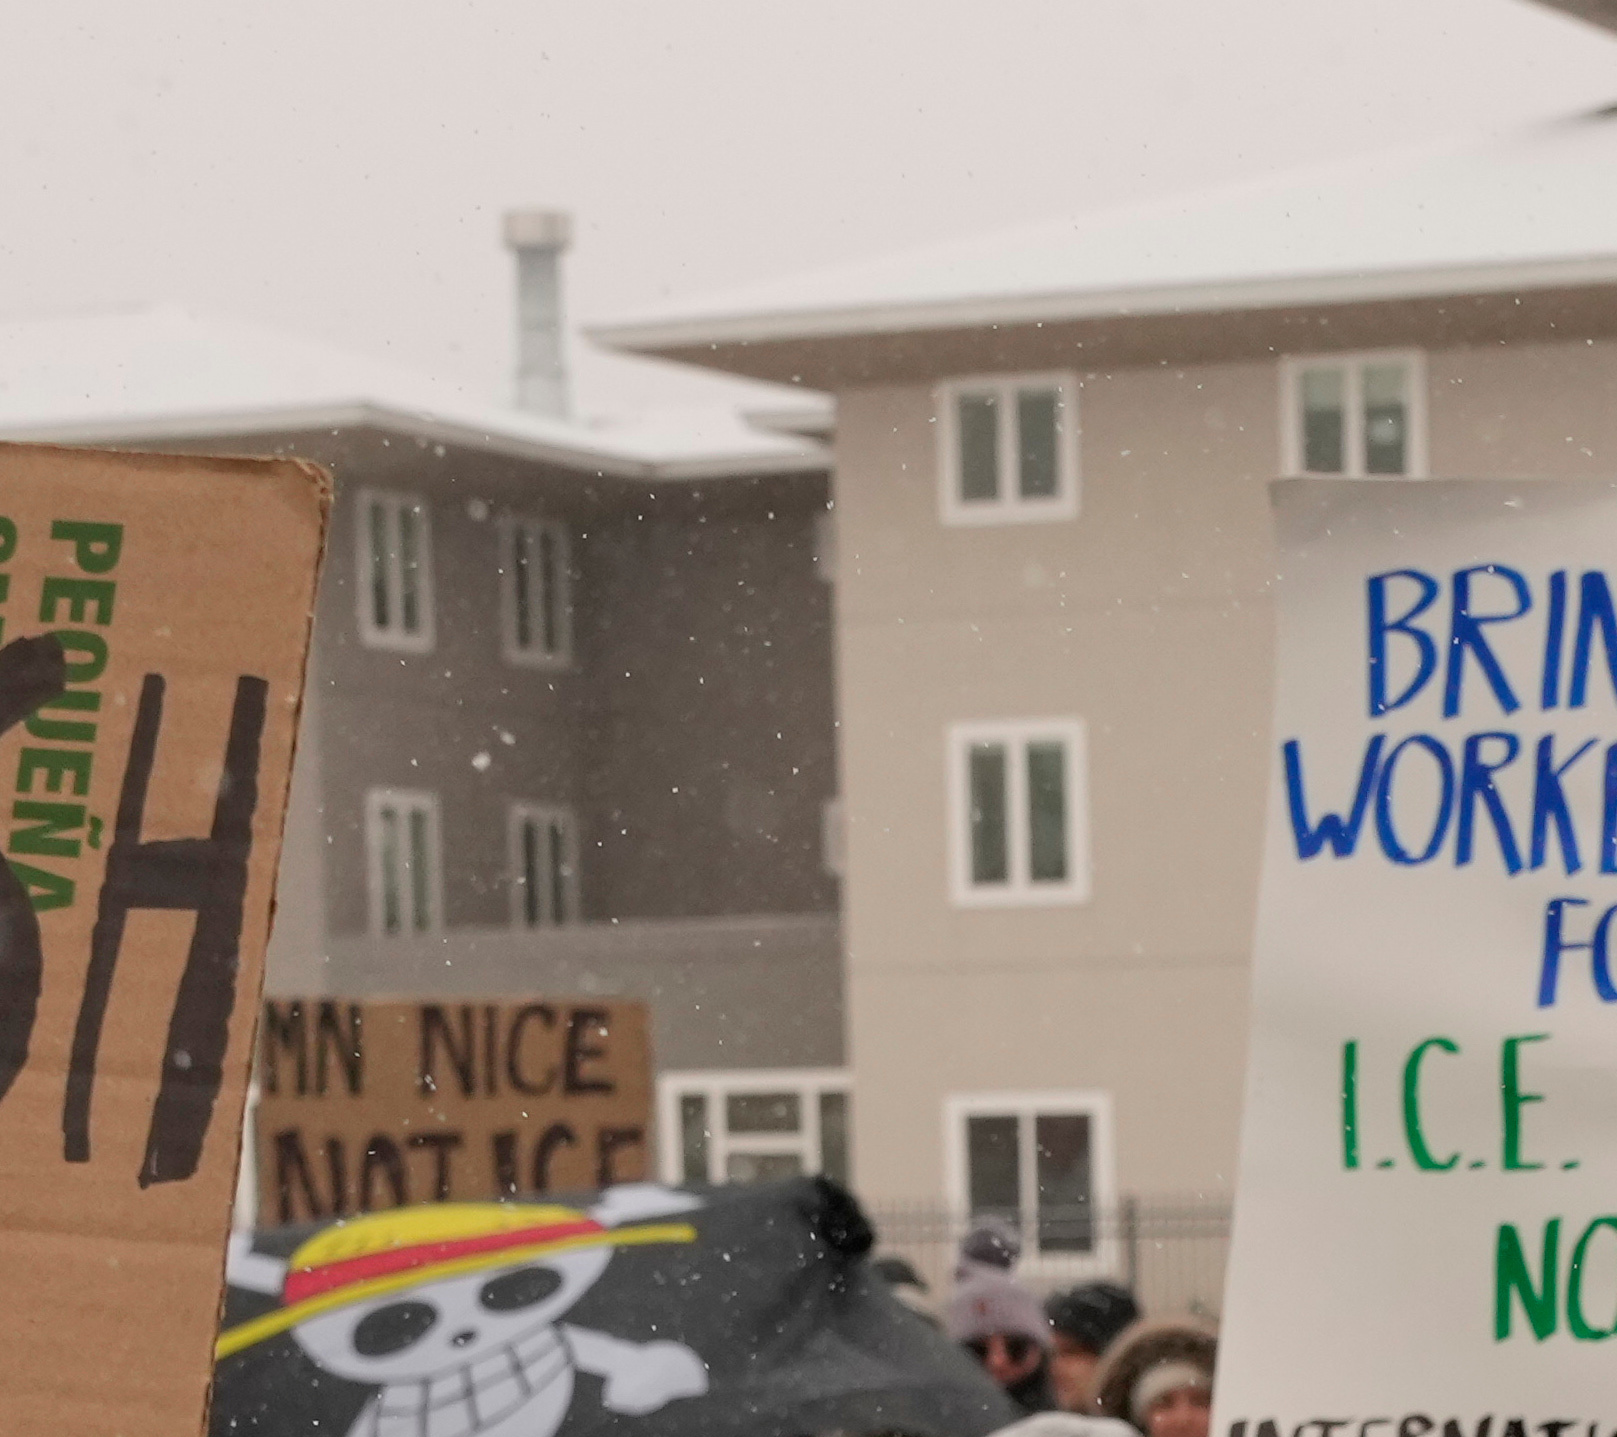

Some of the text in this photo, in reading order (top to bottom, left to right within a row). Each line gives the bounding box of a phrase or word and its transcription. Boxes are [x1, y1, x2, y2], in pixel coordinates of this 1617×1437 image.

[263, 1000, 616, 1098] MN NICE
[1340, 1034, 1581, 1172] I.C.E.
[274, 1127, 461, 1224] NOT
